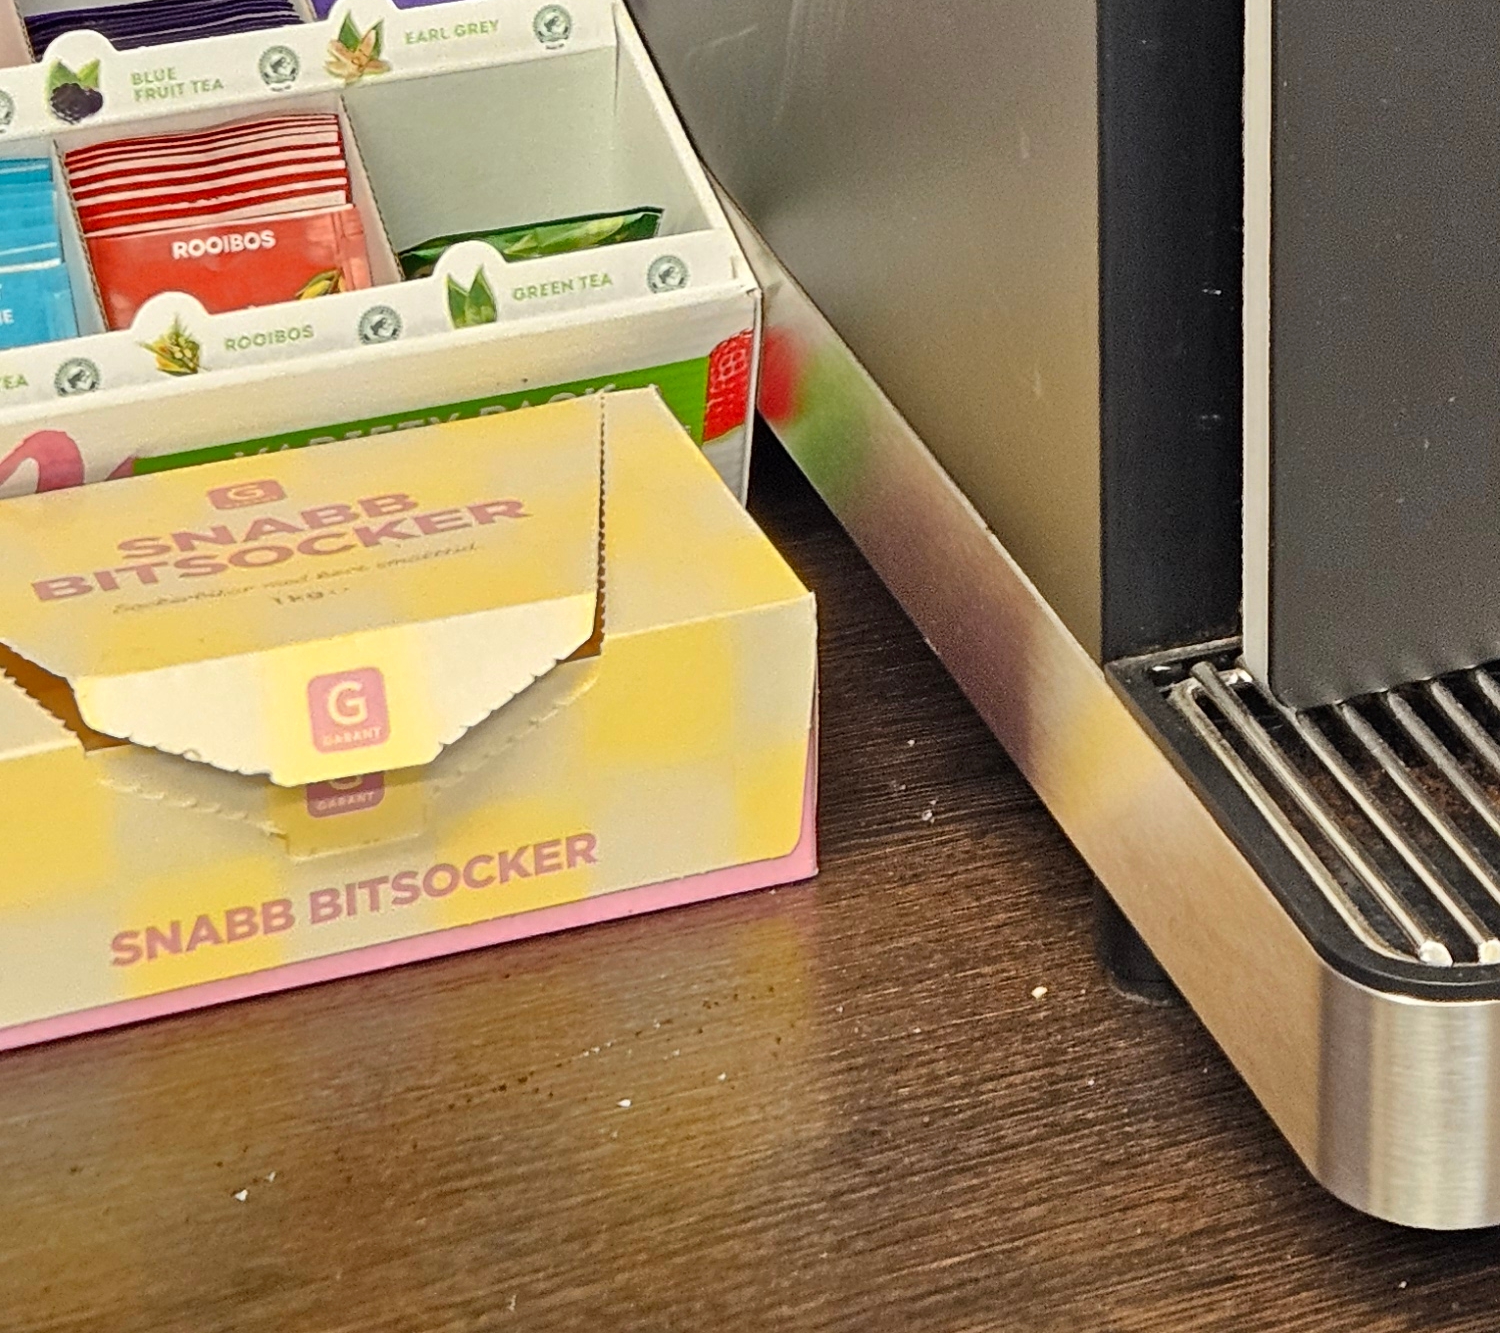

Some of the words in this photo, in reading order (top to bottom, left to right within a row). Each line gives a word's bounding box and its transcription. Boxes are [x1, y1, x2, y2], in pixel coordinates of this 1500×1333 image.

[404, 26, 450, 45] EARL
[453, 19, 500, 39] GREY
[131, 66, 176, 84] BLUE
[133, 82, 184, 102] FRUIT
[192, 78, 224, 94] TEA
[171, 229, 276, 260] ROOIBOS
[512, 281, 574, 302] GREEN
[578, 273, 613, 290] TEA
[223, 325, 314, 351] ROOIBOS
[117, 493, 419, 560] SNABB
[31, 499, 533, 601] BITSOCKER
[327, 680, 368, 725] G
[322, 726, 382, 747] GARANT
[315, 791, 375, 811] GARANT
[110, 898, 297, 967] SNABB
[309, 832, 599, 926] BITSOCKER
